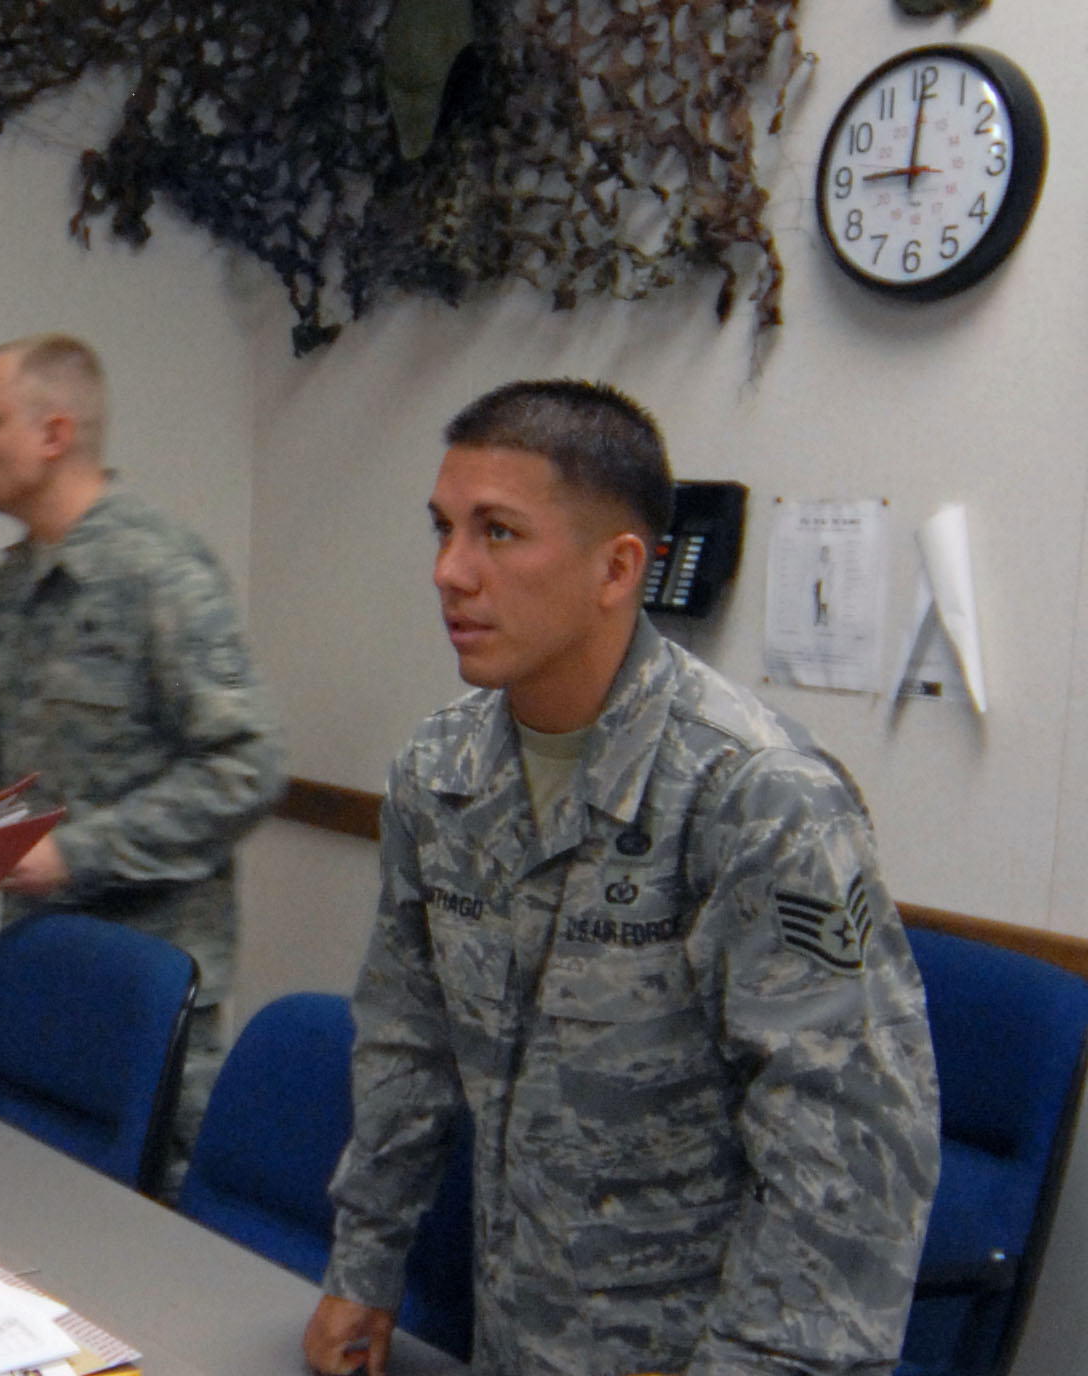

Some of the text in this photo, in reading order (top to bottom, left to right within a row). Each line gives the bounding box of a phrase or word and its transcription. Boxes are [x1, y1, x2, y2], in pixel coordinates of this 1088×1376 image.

[911, 66, 939, 102] 12
[959, 73, 967, 106] 1
[880, 87, 895, 120] 11
[974, 100, 995, 135] 2
[849, 122, 873, 155] 10
[986, 141, 1006, 176] 3
[835, 167, 853, 199] 9
[968, 192, 988, 224] 4
[845, 209, 863, 241] 8
[870, 234, 888, 264] 7
[902, 240, 921, 273] 6
[940, 225, 959, 259] 5
